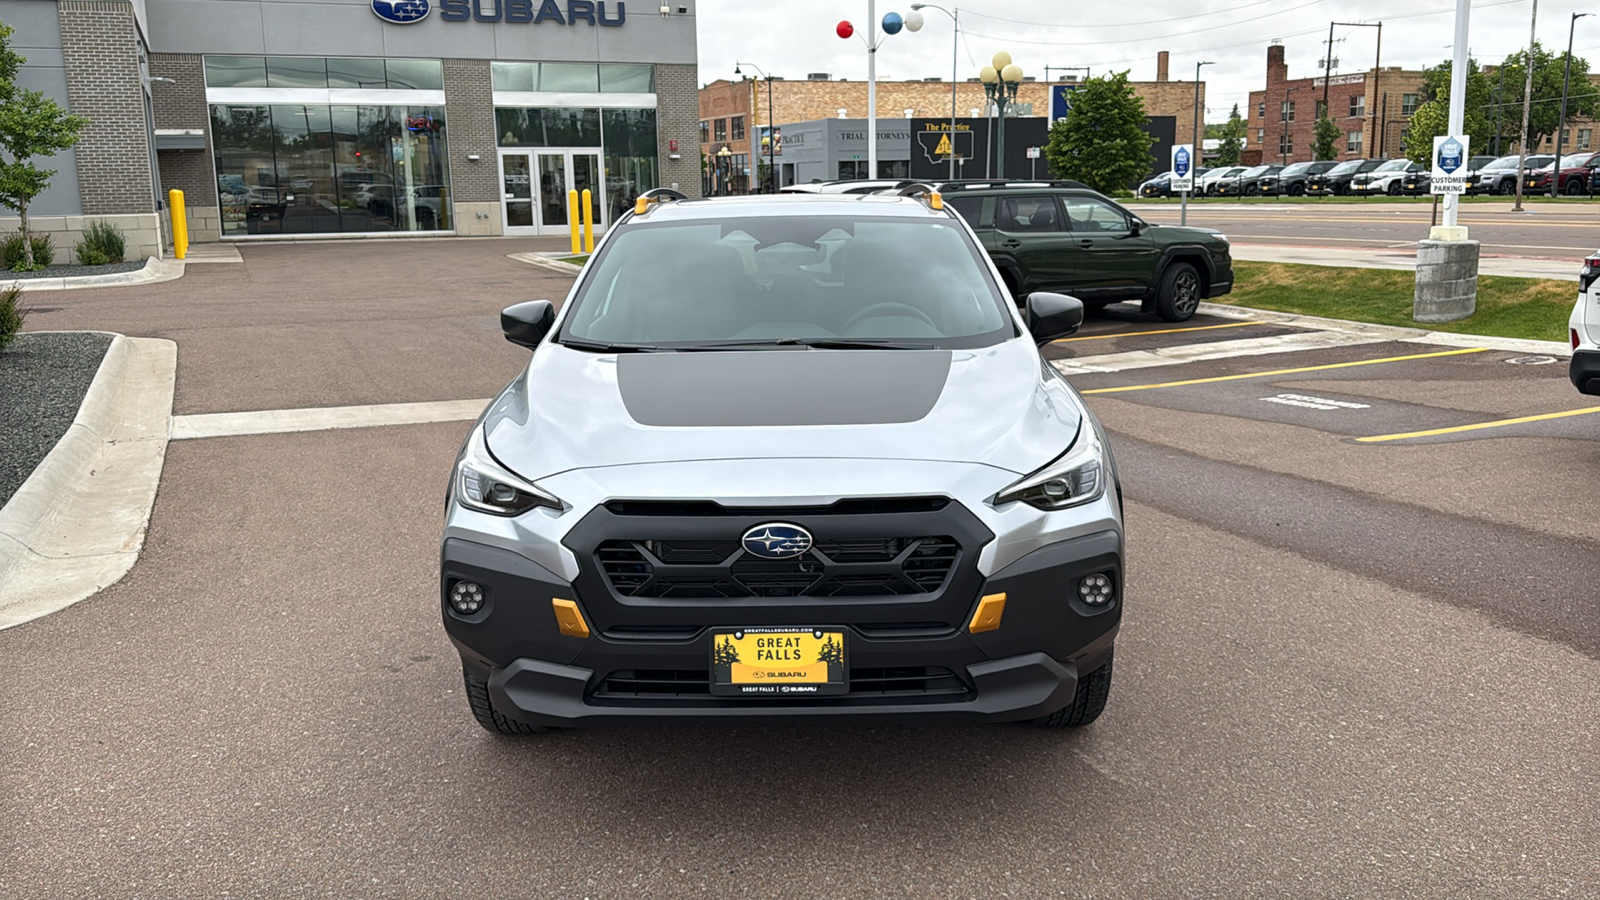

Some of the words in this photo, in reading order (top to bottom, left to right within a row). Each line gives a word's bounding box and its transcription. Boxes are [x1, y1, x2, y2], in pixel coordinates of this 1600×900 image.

[440, 0, 626, 26] SUBARU
[925, 123, 940, 131] The
[841, 132, 865, 140] TRIAL
[866, 132, 911, 140] TORNEYS
[757, 638, 801, 648] GREAT
[757, 649, 801, 660] FALLS
